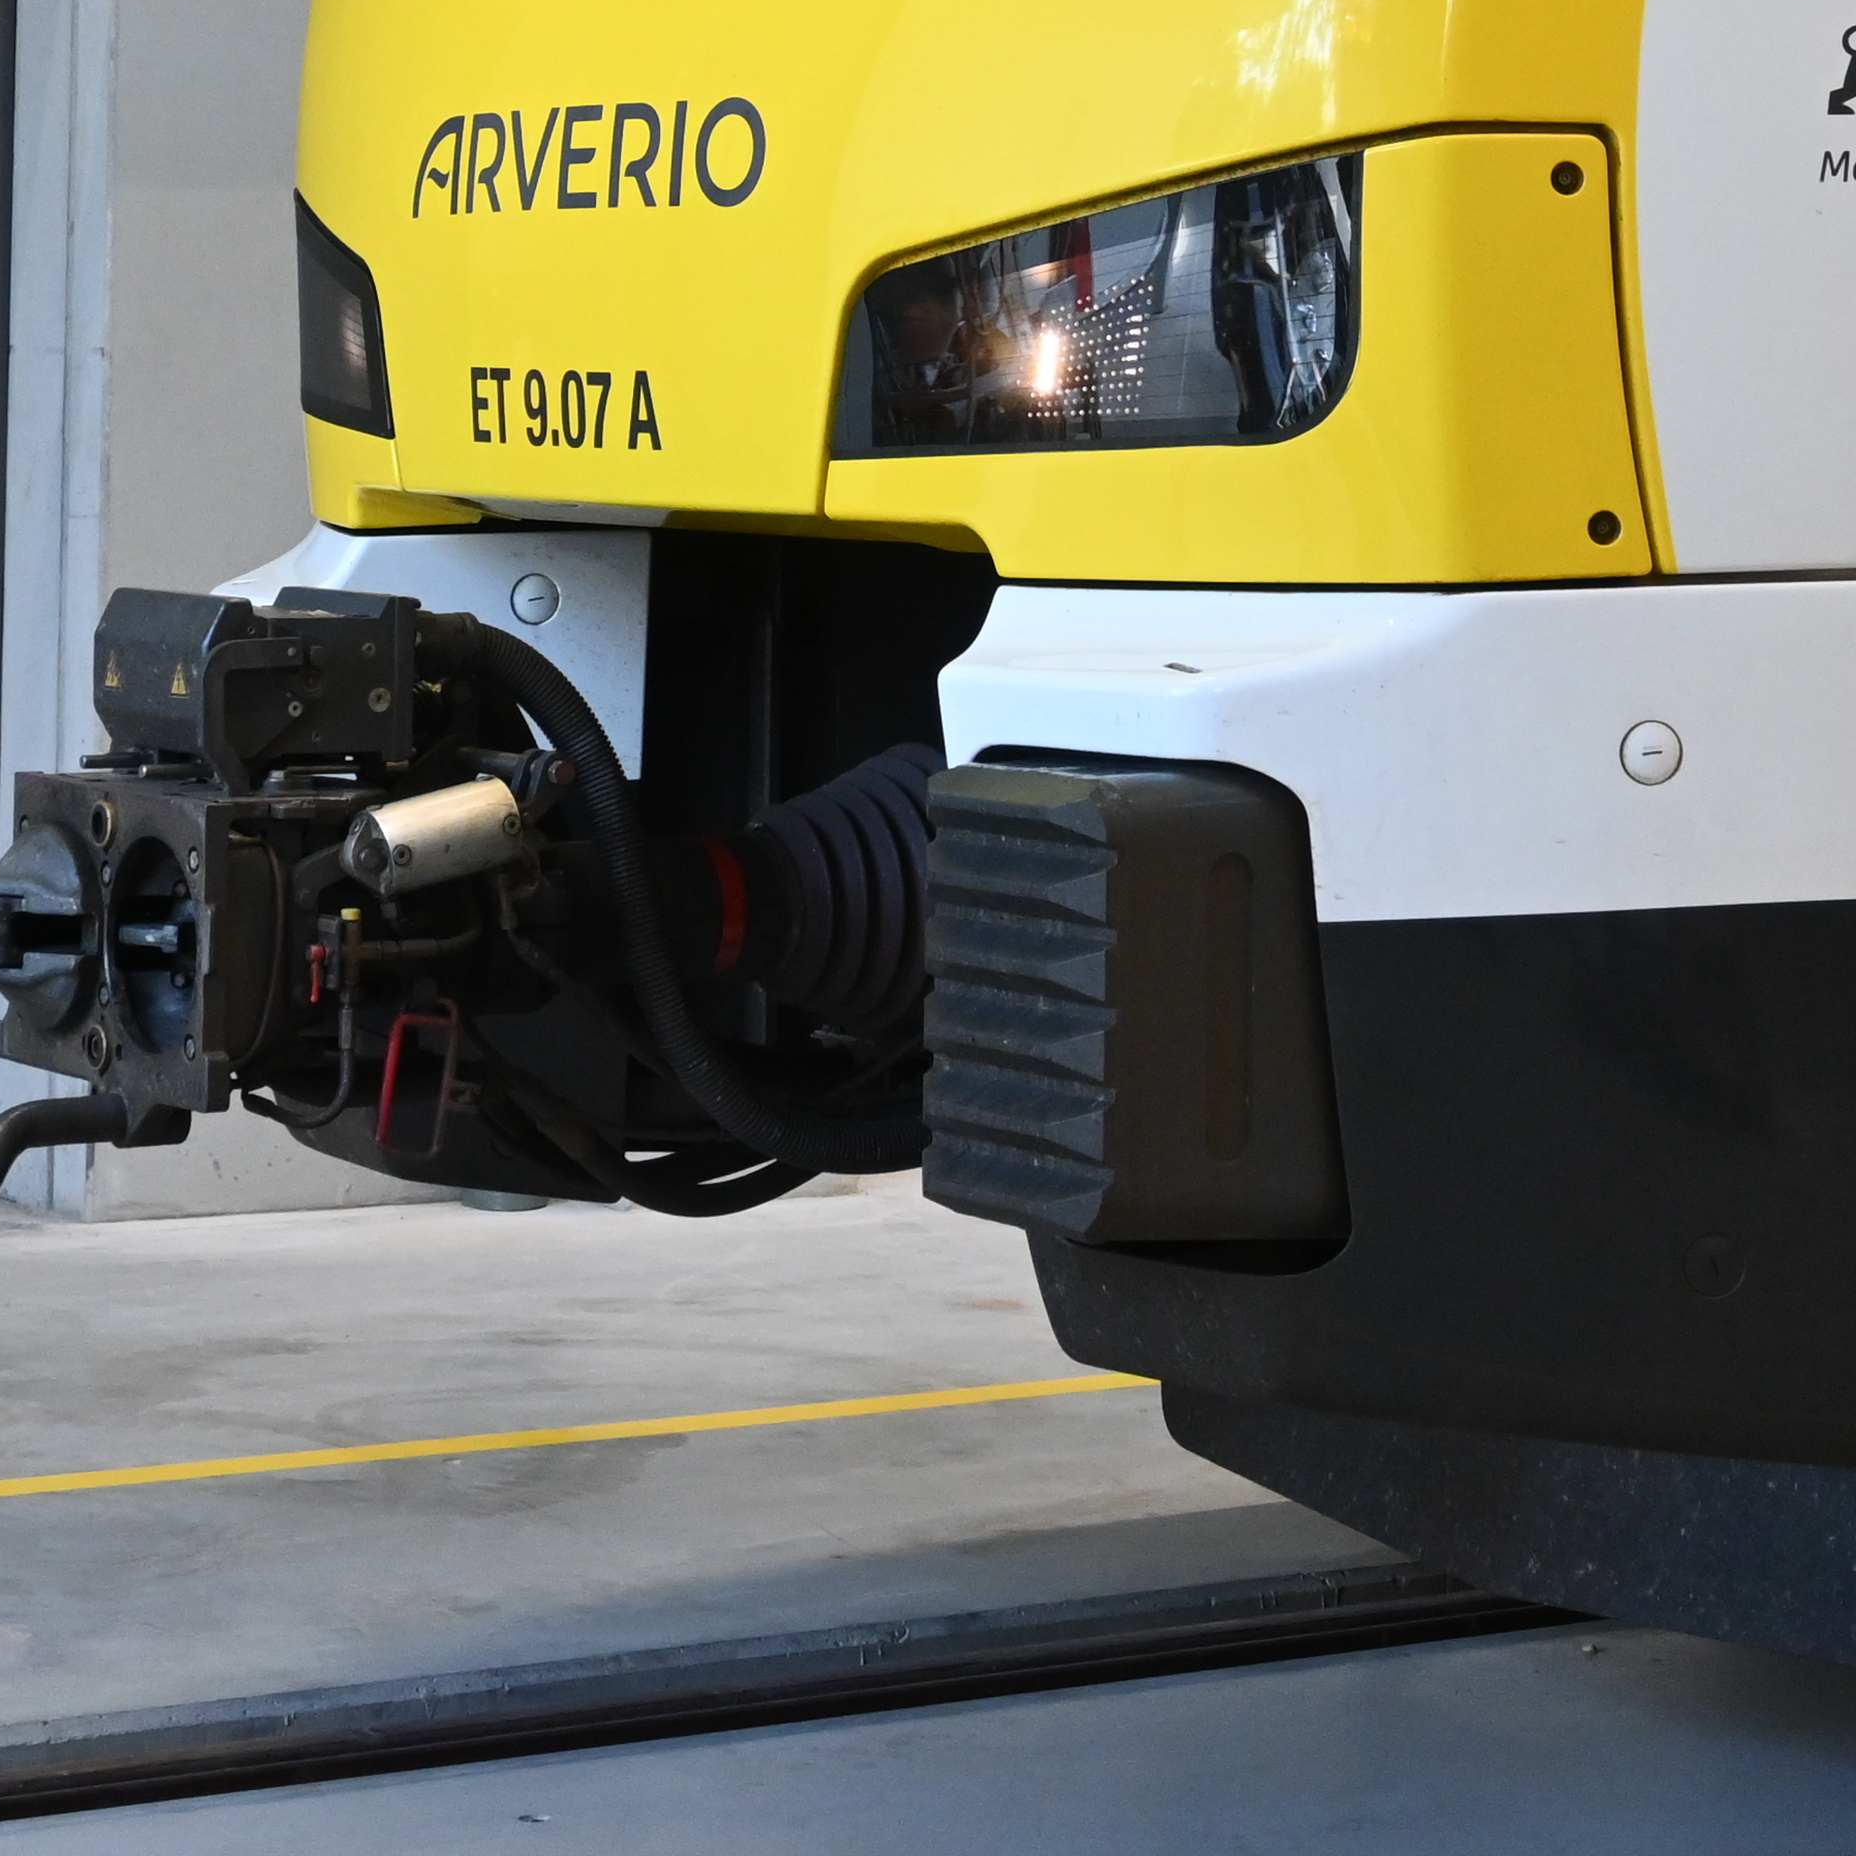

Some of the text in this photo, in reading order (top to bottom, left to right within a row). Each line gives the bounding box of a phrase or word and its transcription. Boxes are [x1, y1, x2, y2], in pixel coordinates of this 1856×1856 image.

[412, 96, 767, 219] ARVERIO
[470, 366, 662, 451] ET 9.07 A
